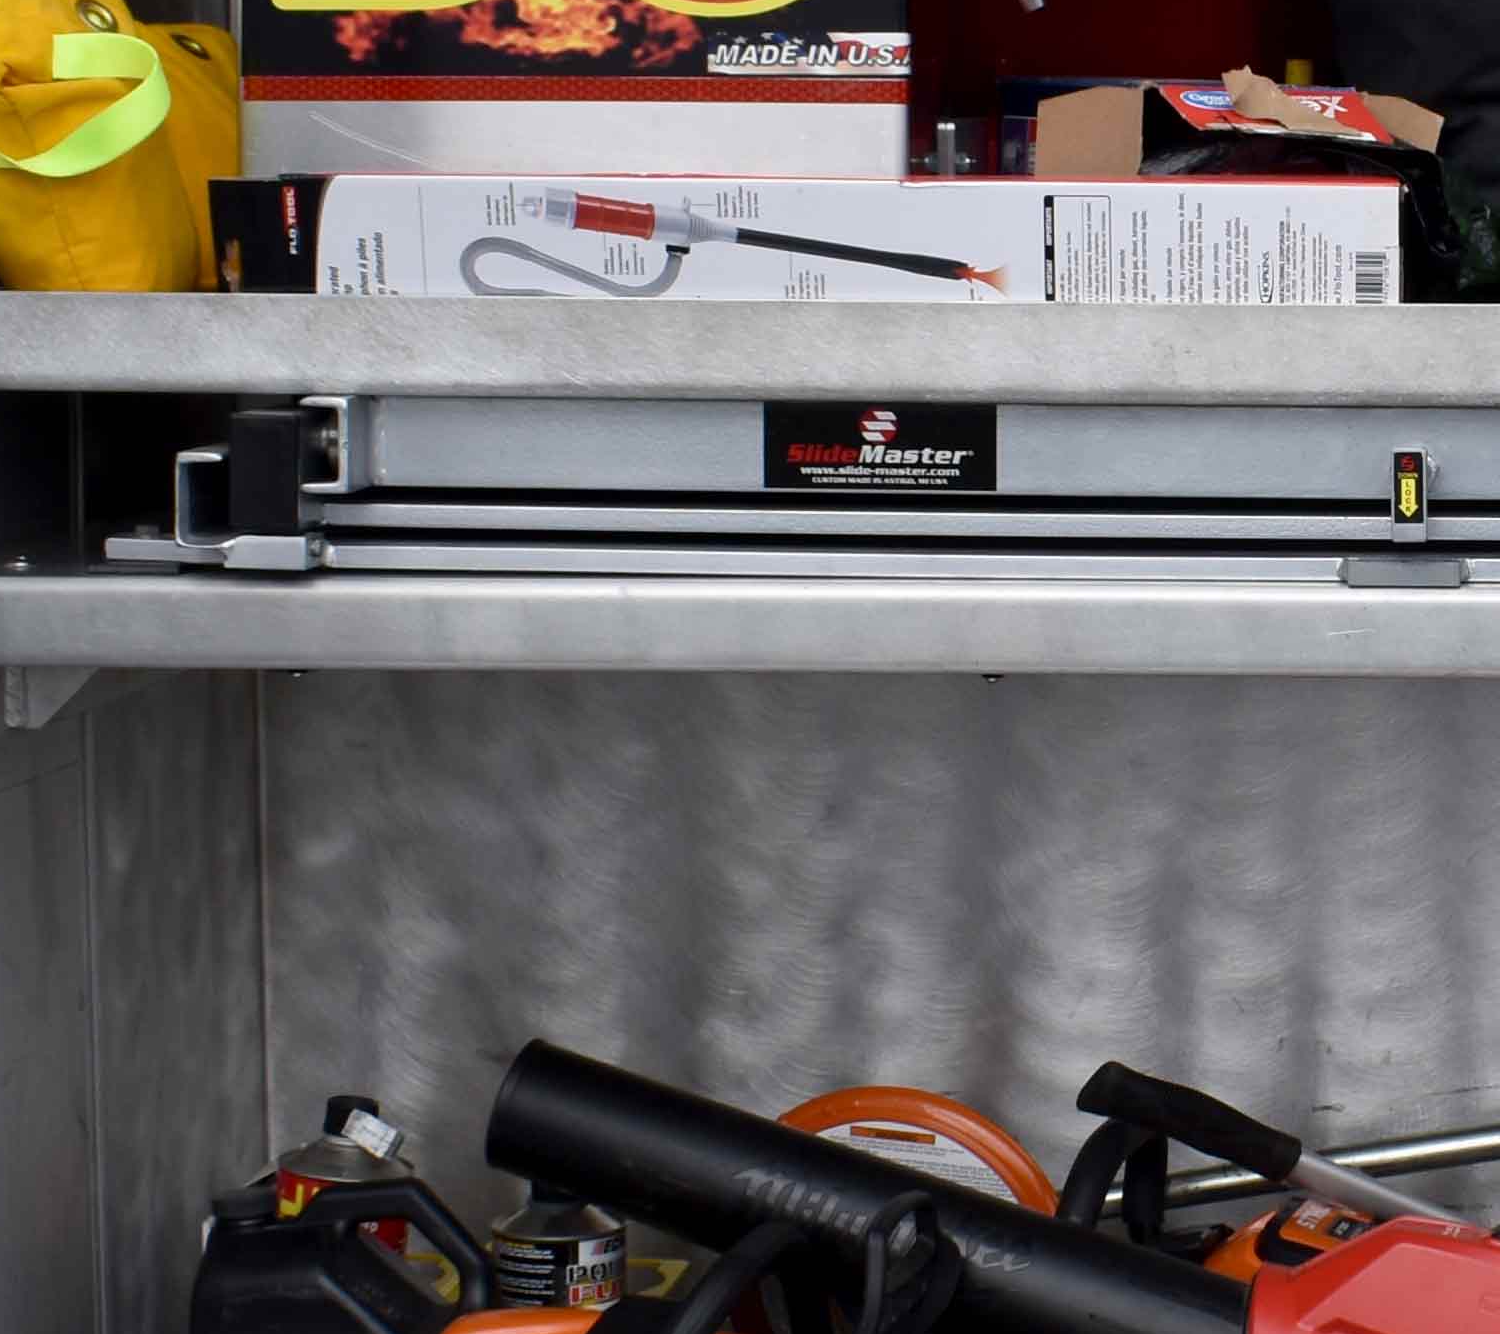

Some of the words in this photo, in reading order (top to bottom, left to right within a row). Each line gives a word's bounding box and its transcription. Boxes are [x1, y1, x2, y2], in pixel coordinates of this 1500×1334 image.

[715, 44, 798, 65] MADE
[808, 44, 838, 65] IN
[788, 443, 968, 464] SlideMaster
[800, 466, 960, 476] www.slide-master.com
